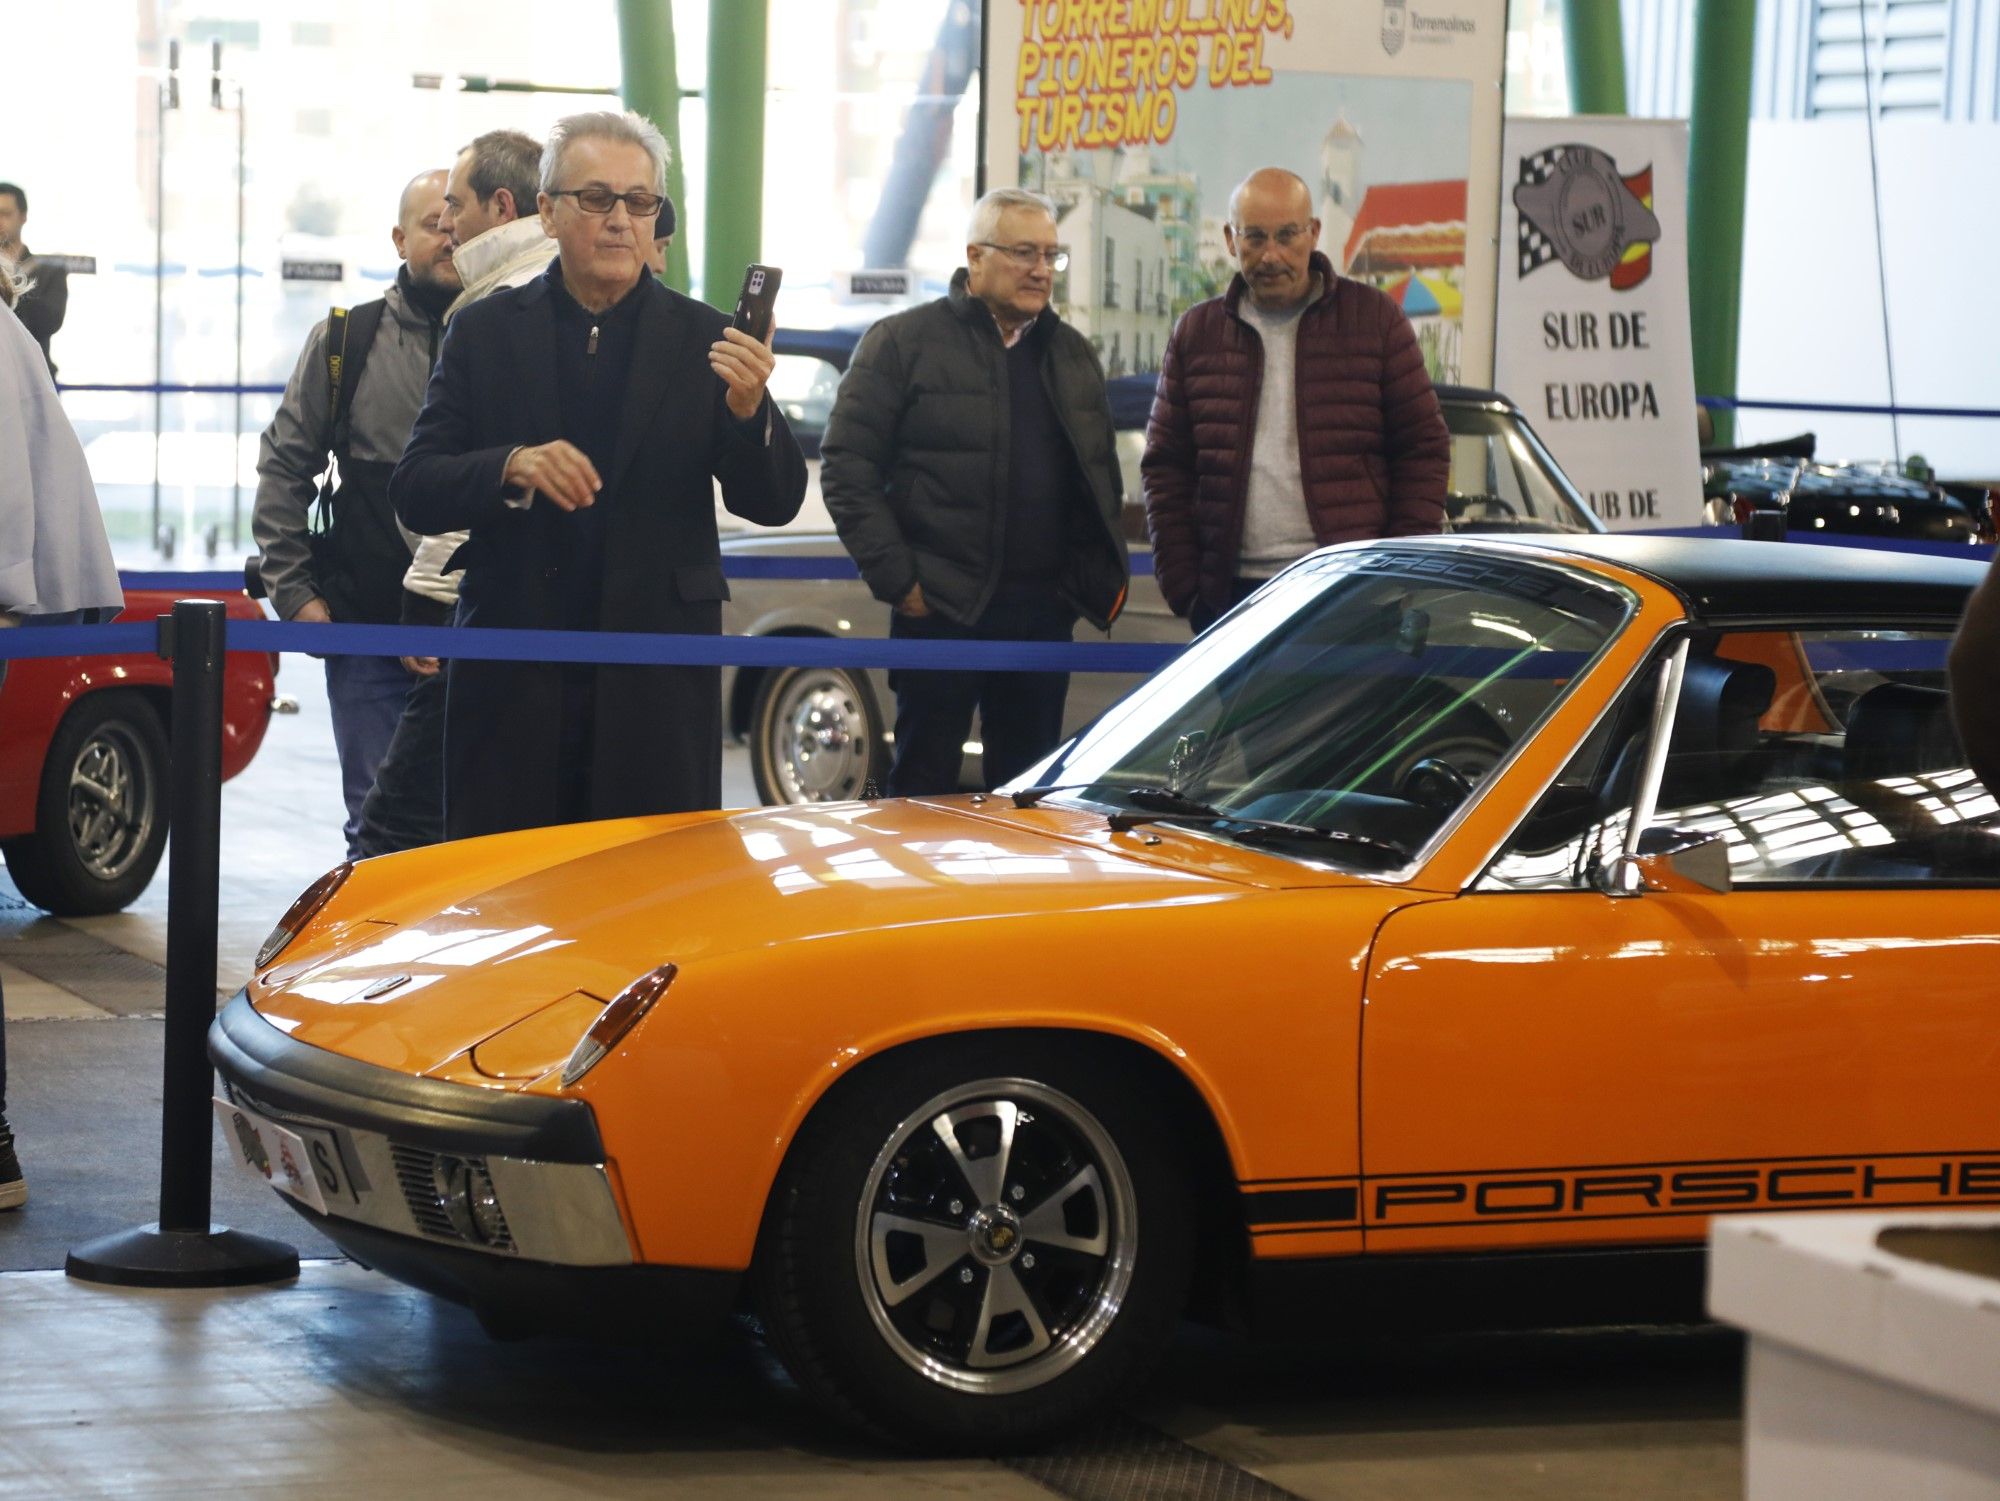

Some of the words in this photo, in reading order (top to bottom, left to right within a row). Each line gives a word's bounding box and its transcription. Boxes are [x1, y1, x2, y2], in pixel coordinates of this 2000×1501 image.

[1016, 34, 1200, 98] PIONEROS
[1208, 32, 1274, 89] DEL
[1016, 87, 1178, 154] TURISMO
[1572, 204, 1607, 239] SUR
[1542, 310, 1599, 350] SUR
[1609, 311, 1650, 350] DE
[1544, 381, 1660, 420] EUROPA
[1628, 489, 1661, 519] DE
